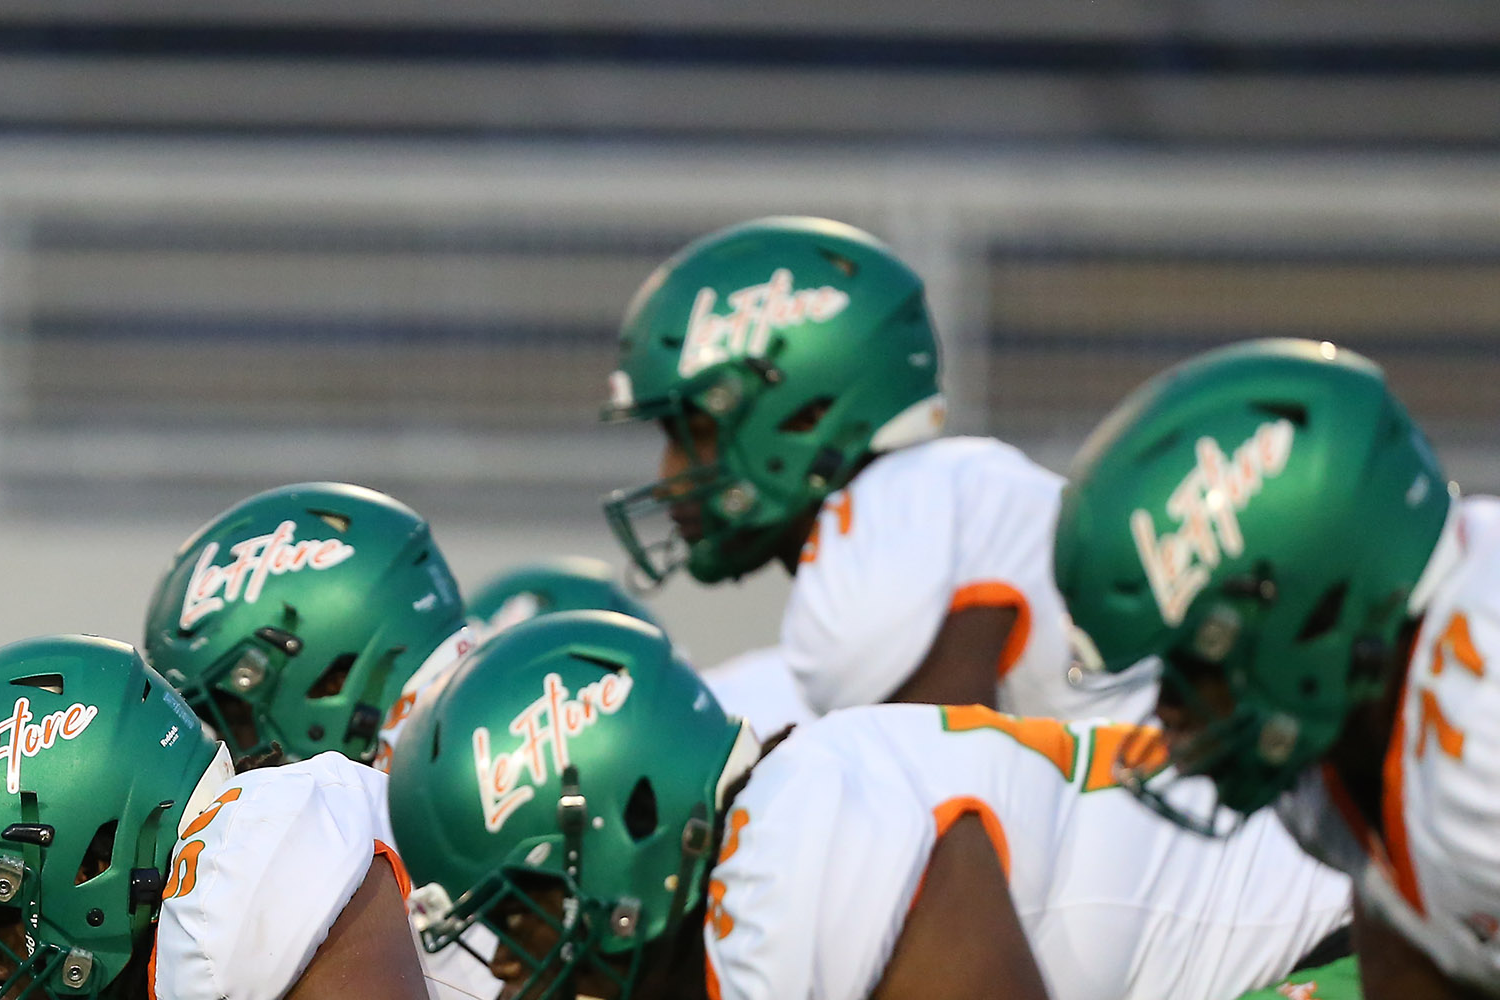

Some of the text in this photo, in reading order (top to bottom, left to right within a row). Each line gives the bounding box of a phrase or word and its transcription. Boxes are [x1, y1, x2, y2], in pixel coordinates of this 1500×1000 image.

[677, 267, 850, 378] LeFlore
[180, 520, 355, 630] LeFlore
[1130, 418, 1295, 628] LeFlore
[471, 672, 634, 833] LeFlore
